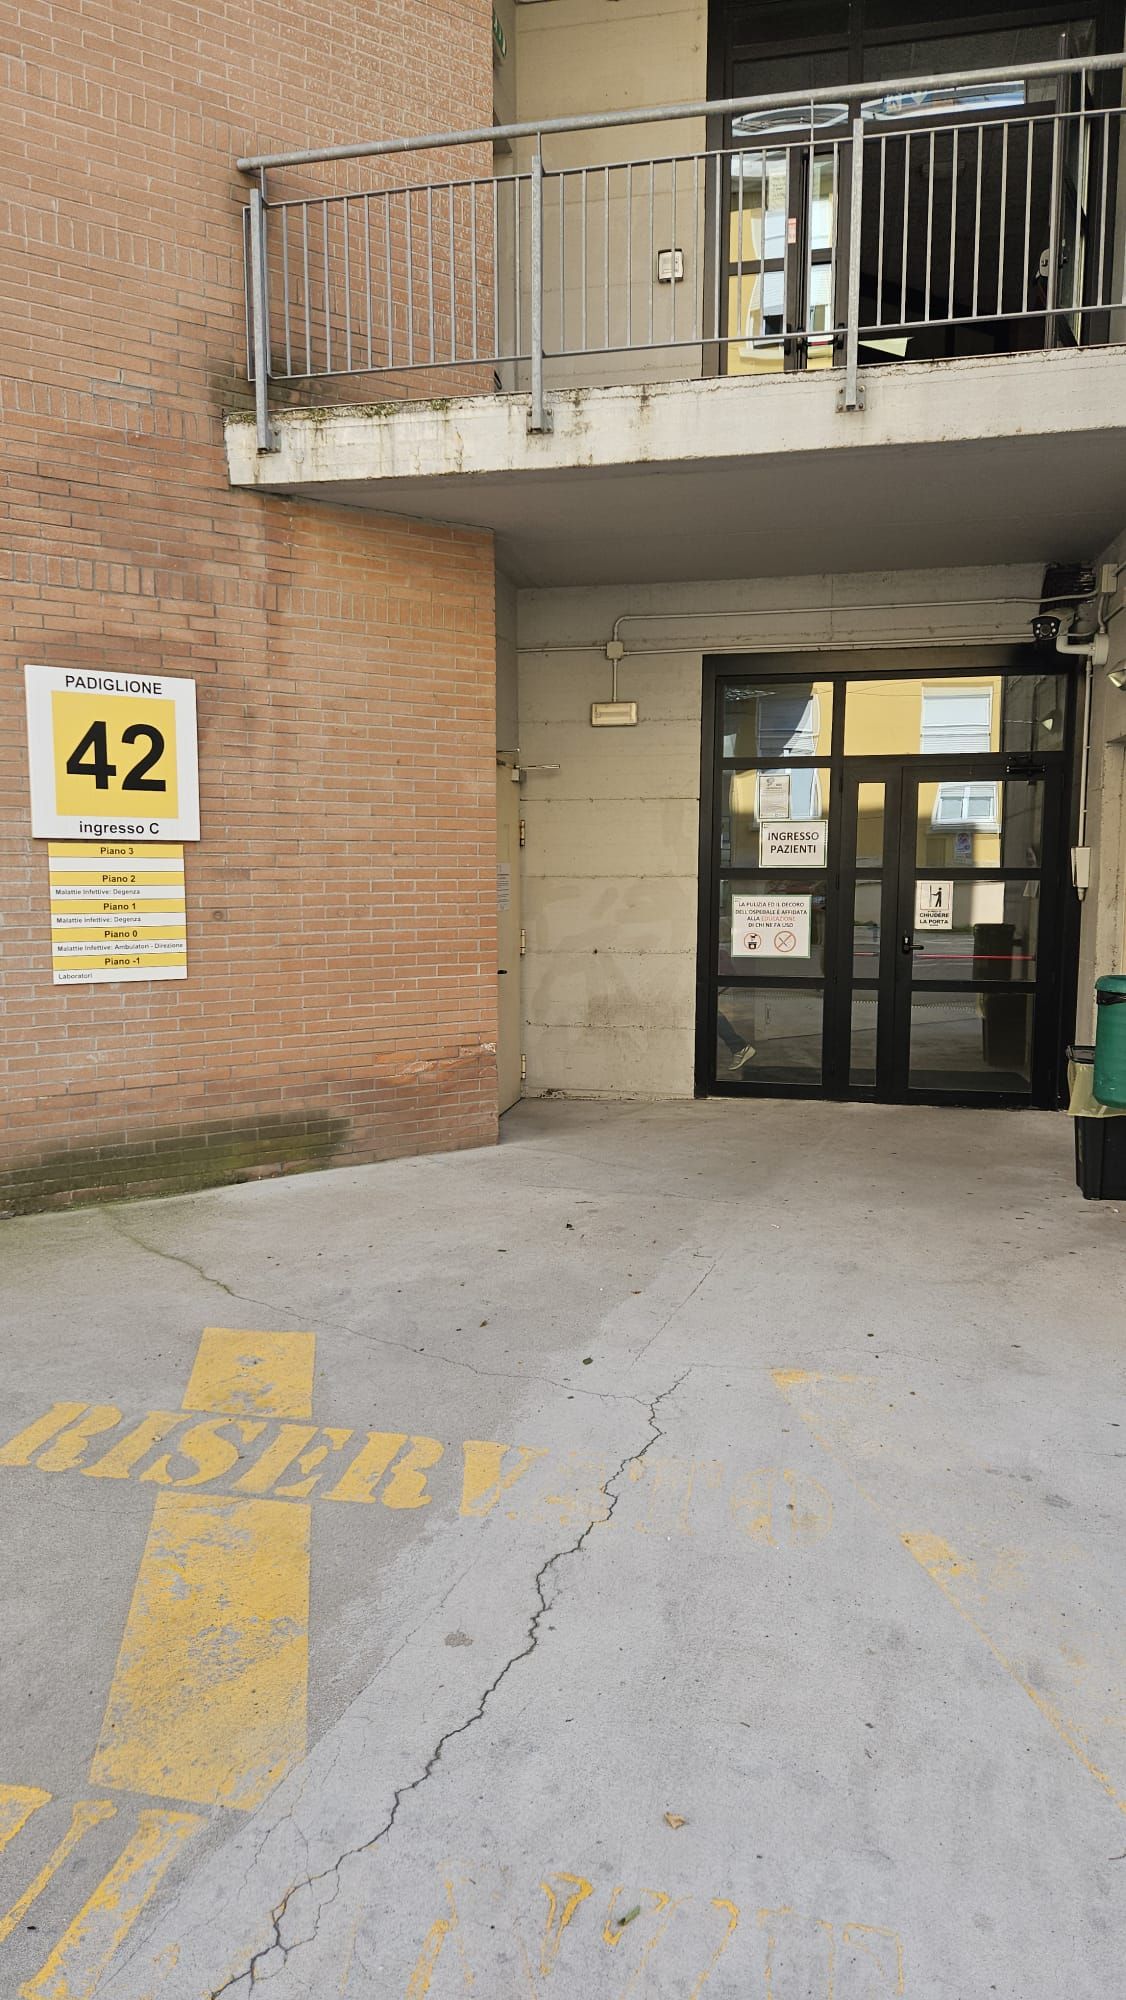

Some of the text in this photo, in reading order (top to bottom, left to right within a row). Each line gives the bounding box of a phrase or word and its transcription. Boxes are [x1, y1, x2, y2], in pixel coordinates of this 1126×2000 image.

[66, 676, 162, 695] PADIGLIONE
[67, 721, 166, 792] 42
[80, 821, 159, 835] ingresso C
[768, 832, 819, 840] INGRESSO
[100, 847, 126, 855] Piano
[770, 845, 816, 853] PAZIENTI
[104, 930, 130, 938] Piano
